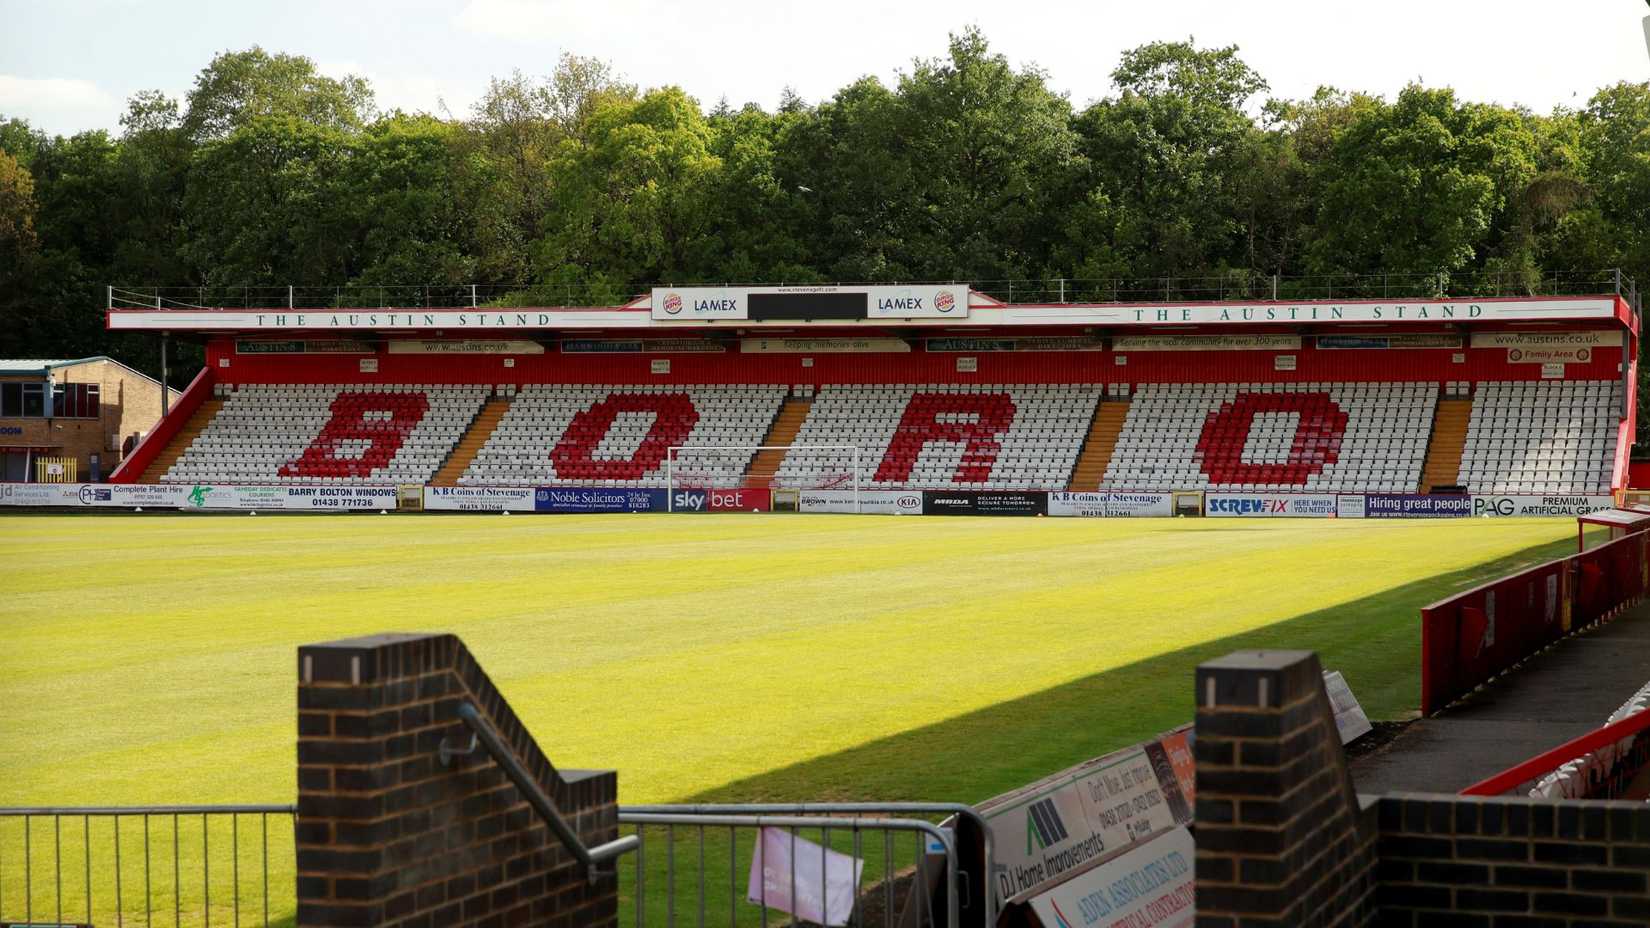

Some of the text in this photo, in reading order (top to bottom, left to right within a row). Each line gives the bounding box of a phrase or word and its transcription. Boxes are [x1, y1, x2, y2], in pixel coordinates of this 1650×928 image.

[665, 300, 682, 310] KING
[694, 300, 737, 311] LAMEX
[878, 298, 922, 310] LAMEX
[936, 298, 954, 307] KING
[1134, 304, 1482, 321] THE AUSTIN STAND
[256, 314, 550, 326] THE AUSTIN STAND
[1495, 331, 1600, 344] www.austins.co.uk
[1525, 350, 1574, 360] Family Area
[114, 486, 147, 494] Complete
[288, 488, 316, 496] BARRY
[356, 489, 396, 497] WINDOWS
[432, 488, 440, 496] K
[442, 488, 450, 496] B
[450, 488, 475, 496] Coins
[476, 488, 486, 496] of
[486, 488, 530, 498] Stevenage
[551, 490, 625, 503] Noble Solicitors
[675, 491, 743, 510] sky bet
[1052, 492, 1060, 501] K
[1062, 492, 1070, 500] B
[1072, 492, 1098, 502] Coins
[1100, 492, 1111, 502] of
[1113, 492, 1162, 504] Stevenage
[1542, 497, 1588, 506] PREMIUM
[342, 499, 373, 507] 771736
[1210, 498, 1288, 515] SCREWFIX
[1369, 497, 1400, 510] Hiring
[1404, 498, 1432, 510] great
[1434, 498, 1470, 511] people
[1474, 497, 1514, 516] PAG
[1520, 506, 1574, 514] ARTIFICIAL
[1016, 862, 1044, 891] Home
[1043, 831, 1105, 877] Improvements
[1078, 889, 1112, 925] ADEN
[1108, 857, 1169, 907] ASSOCIATES
[1167, 851, 1189, 877] LTD
